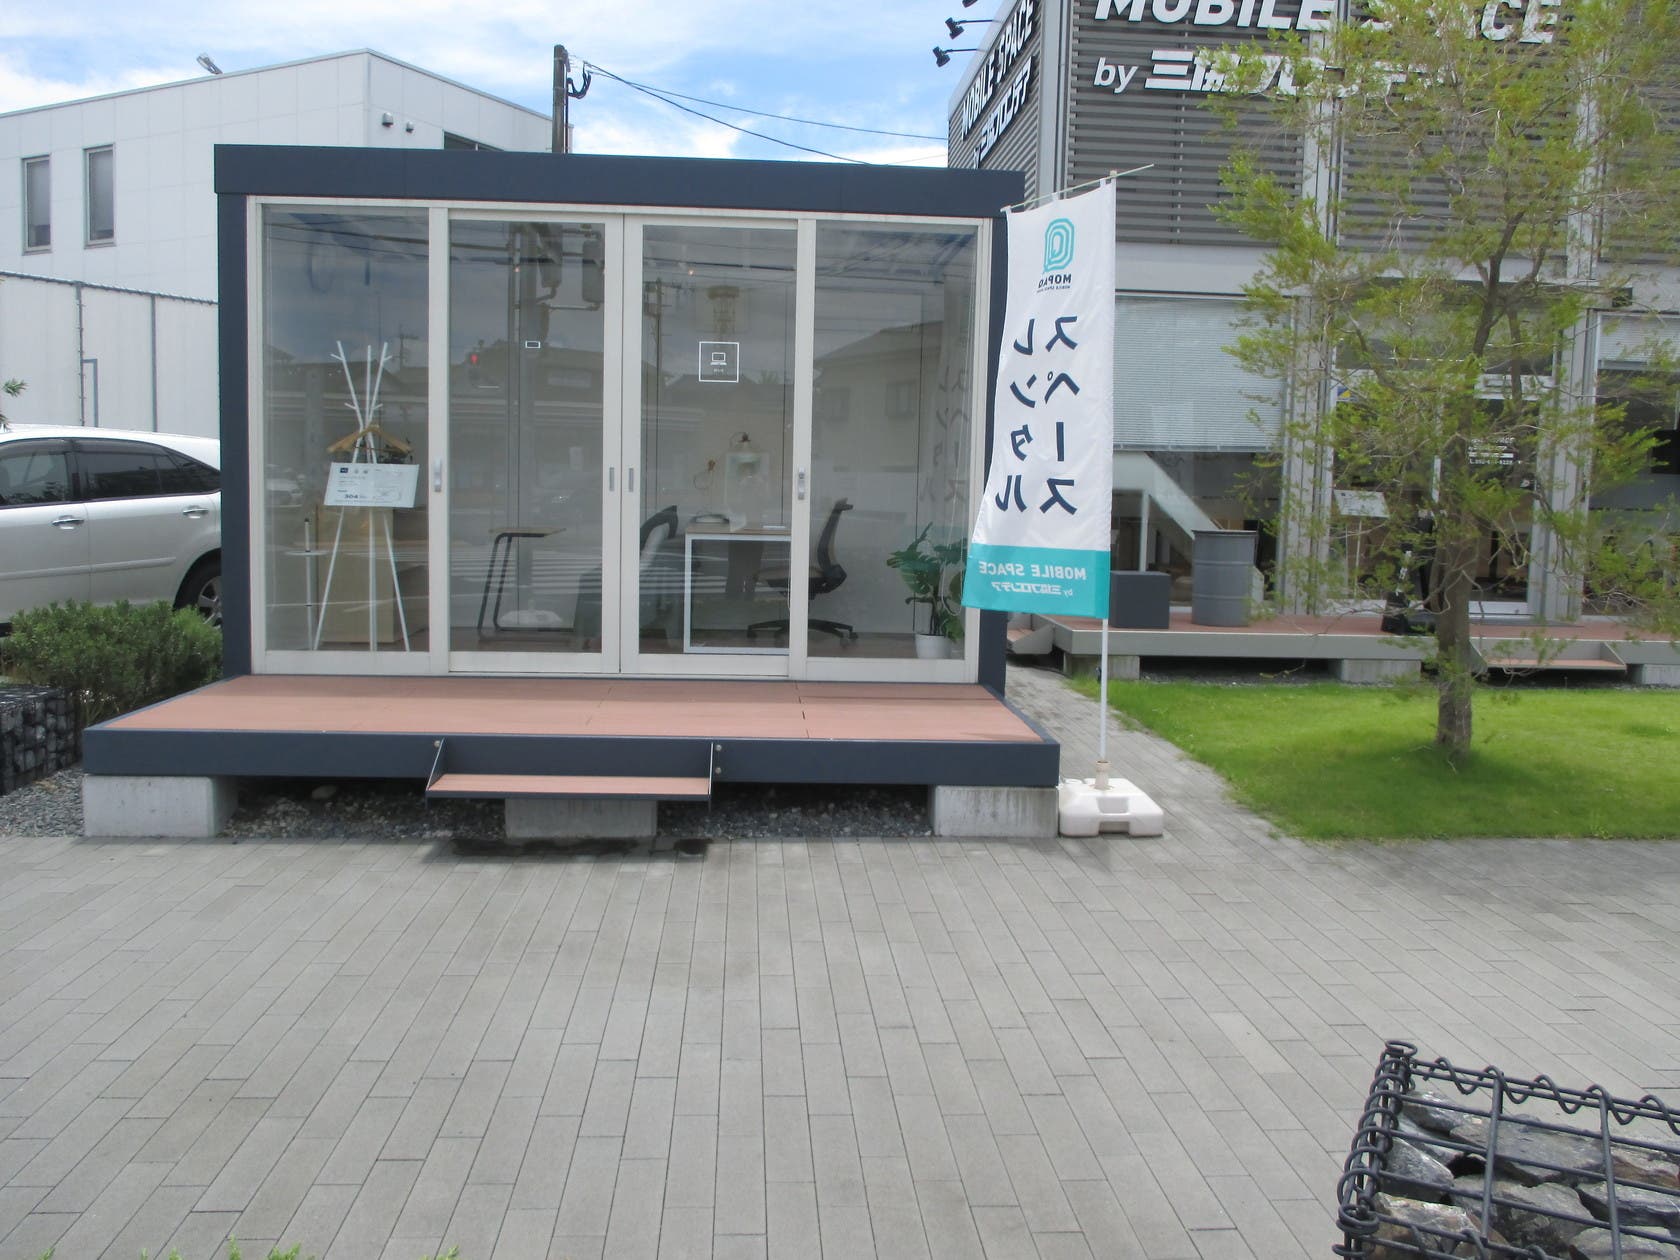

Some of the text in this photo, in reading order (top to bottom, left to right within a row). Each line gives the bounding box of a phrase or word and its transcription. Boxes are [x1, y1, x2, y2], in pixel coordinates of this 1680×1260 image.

[961, 0, 1034, 141] MOBILE SPACE
[1094, 56, 1139, 94] by
